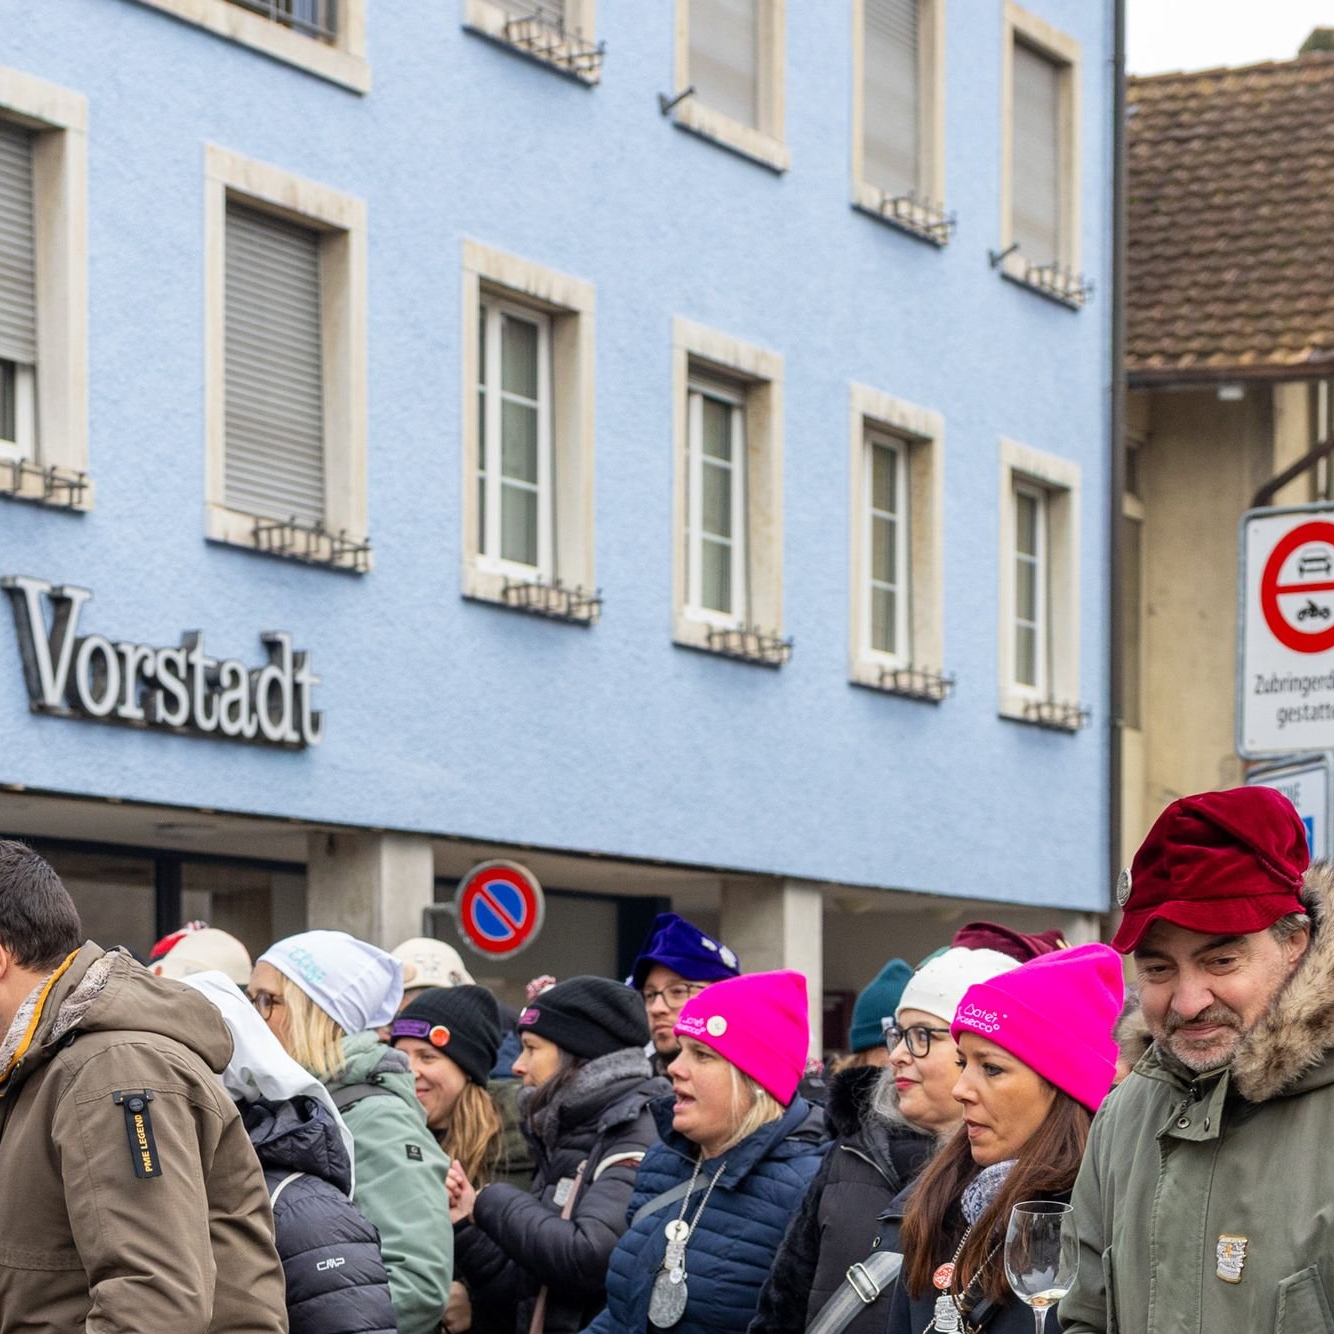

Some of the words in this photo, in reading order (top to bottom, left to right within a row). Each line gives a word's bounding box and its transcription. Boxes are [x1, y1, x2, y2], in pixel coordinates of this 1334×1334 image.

[1, 575, 324, 746] Vorstadt
[134, 1114, 149, 1149] LEGEND
[142, 1151, 153, 1173] PME
[317, 1257, 345, 1271] CMP
